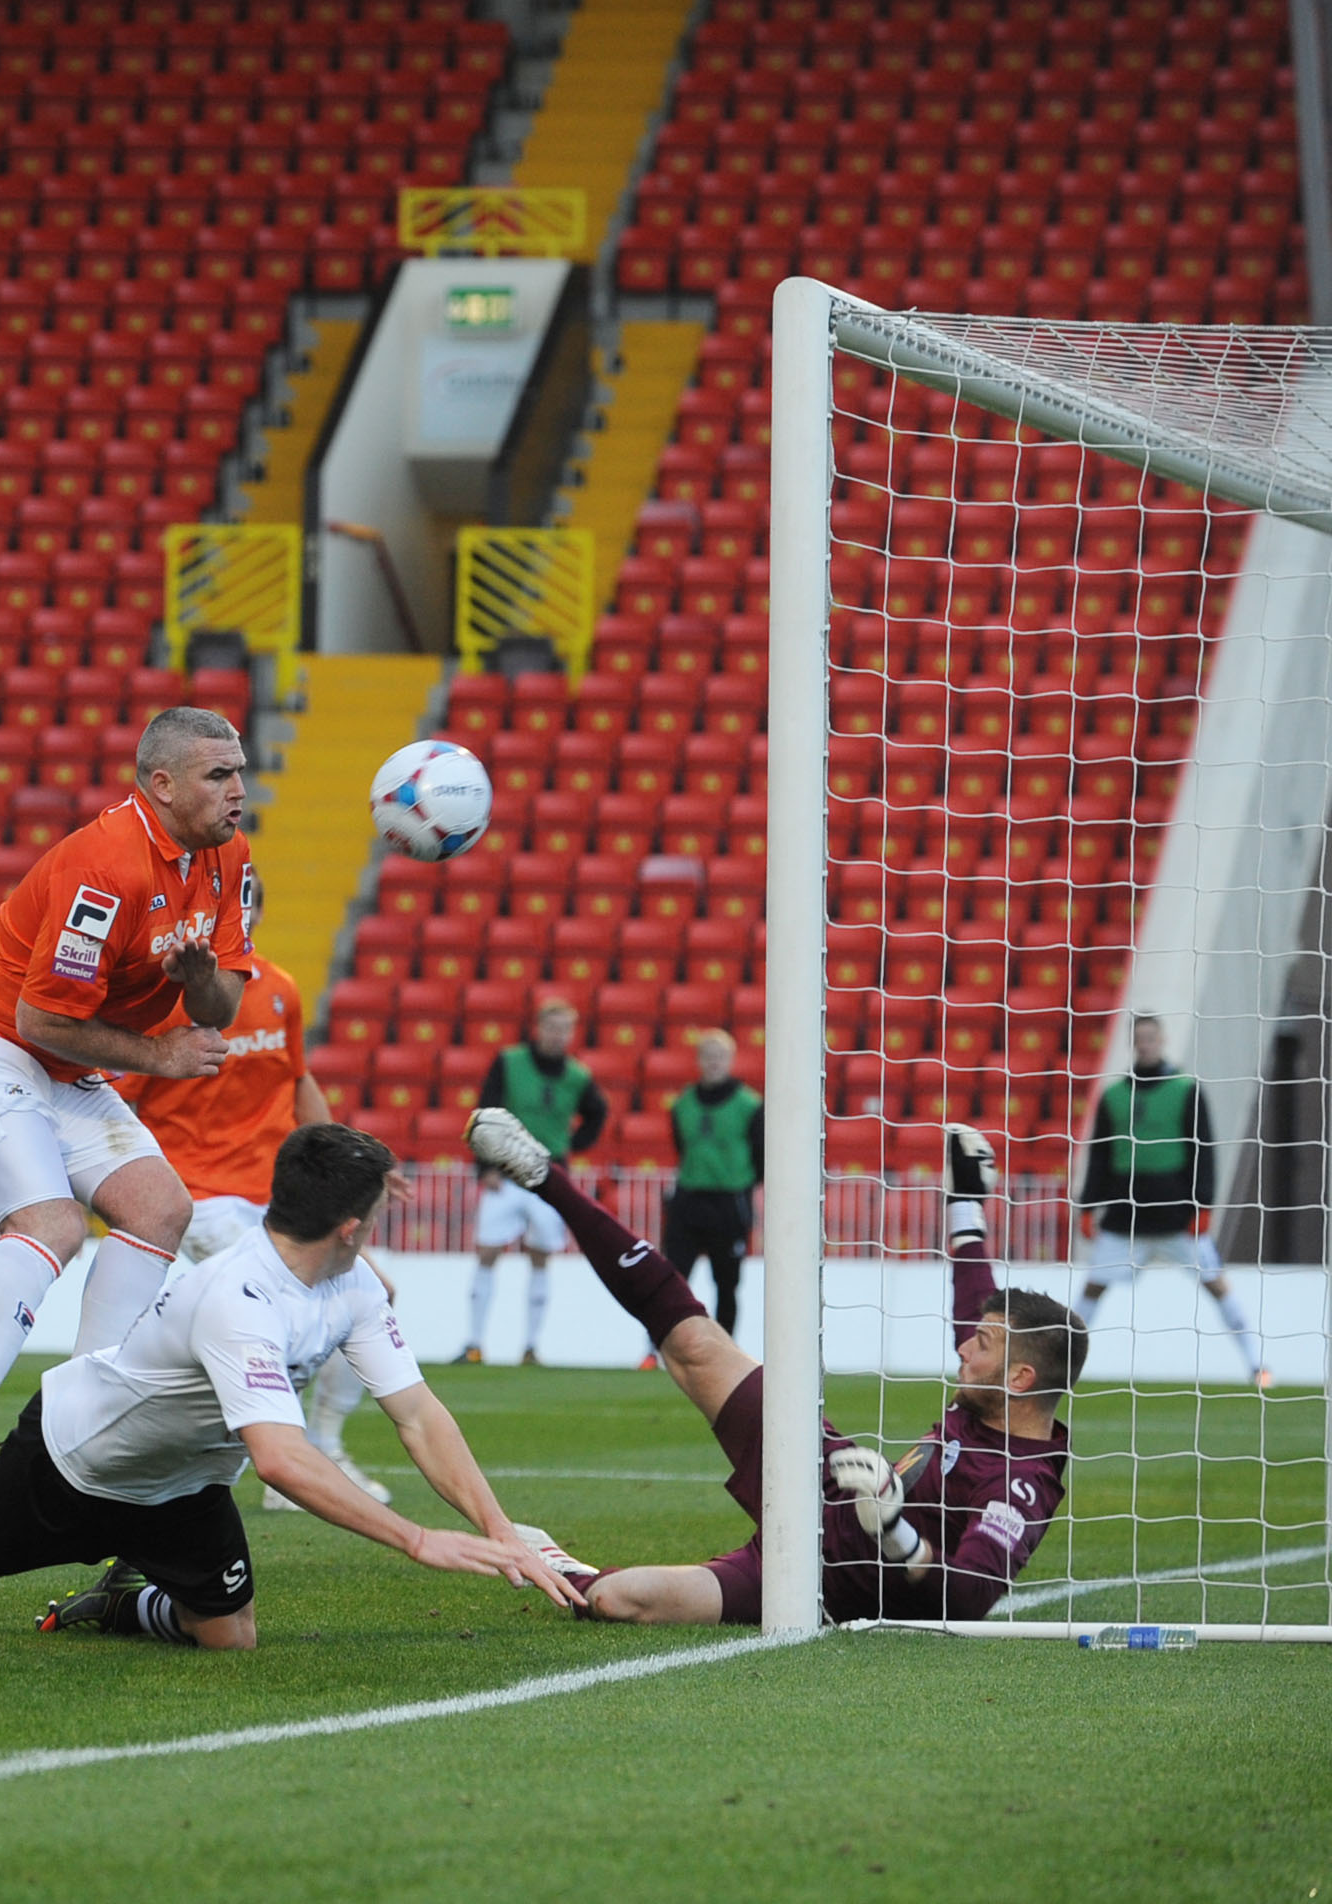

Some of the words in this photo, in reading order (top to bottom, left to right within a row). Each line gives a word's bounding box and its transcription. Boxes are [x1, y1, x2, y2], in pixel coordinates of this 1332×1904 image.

[151, 912, 217, 955] eayJe
[59, 944, 97, 964] Skrill
[54, 961, 94, 979] Premier
